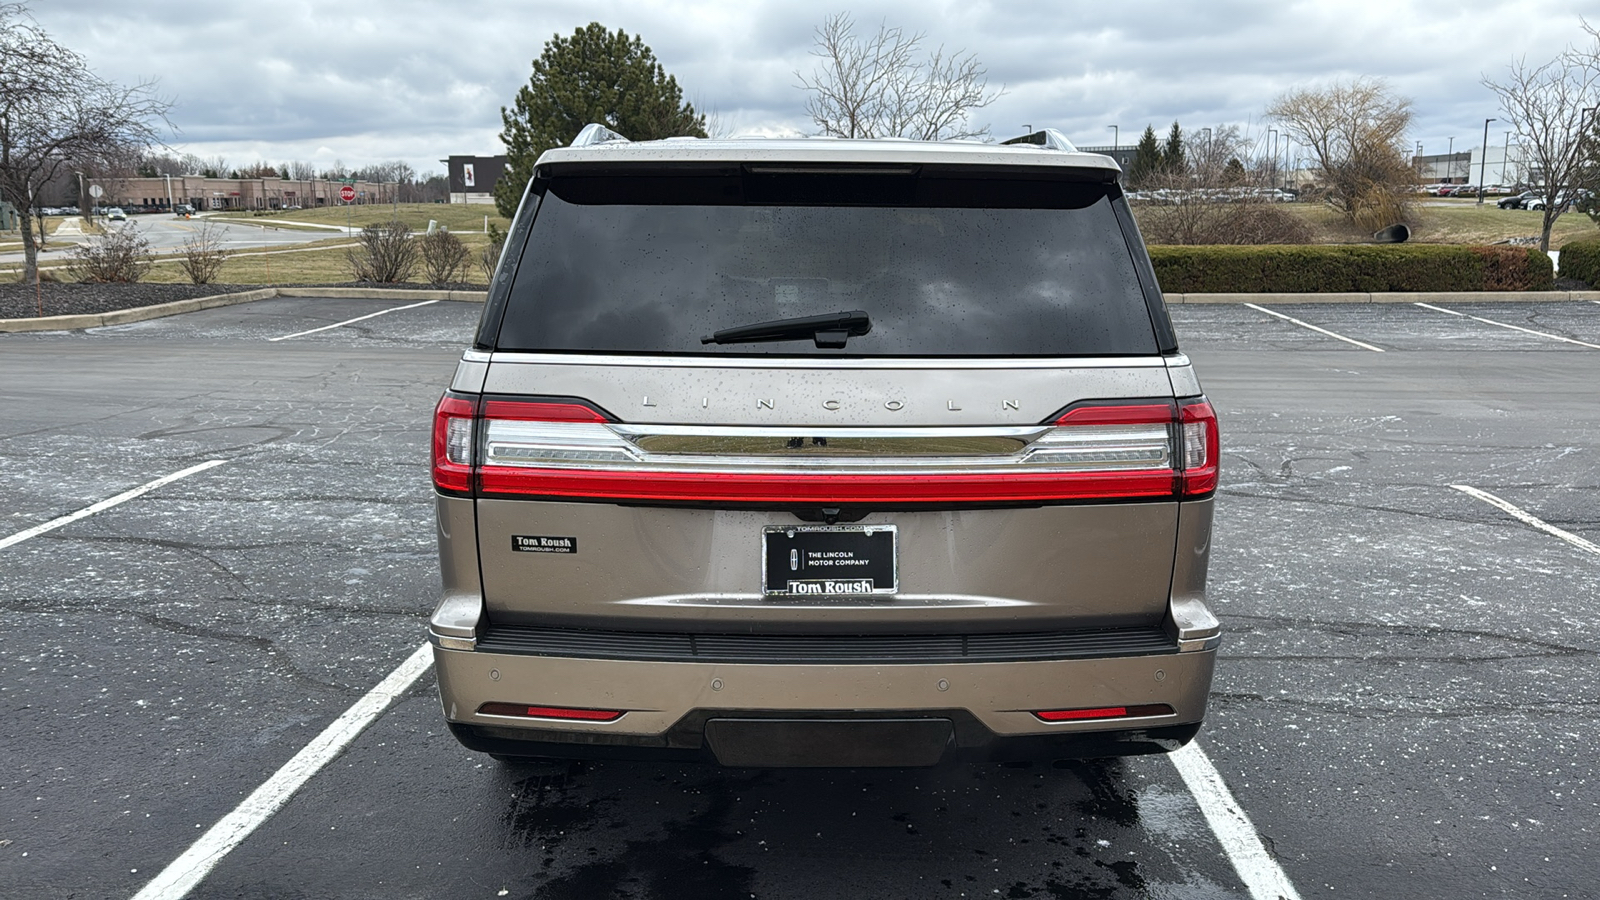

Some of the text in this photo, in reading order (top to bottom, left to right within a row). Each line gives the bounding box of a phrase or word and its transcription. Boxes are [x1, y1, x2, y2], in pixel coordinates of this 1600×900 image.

[643, 396, 1019, 411] LINCOLN
[516, 537, 571, 547] Tom Roush
[789, 580, 872, 594] Tom Roush
